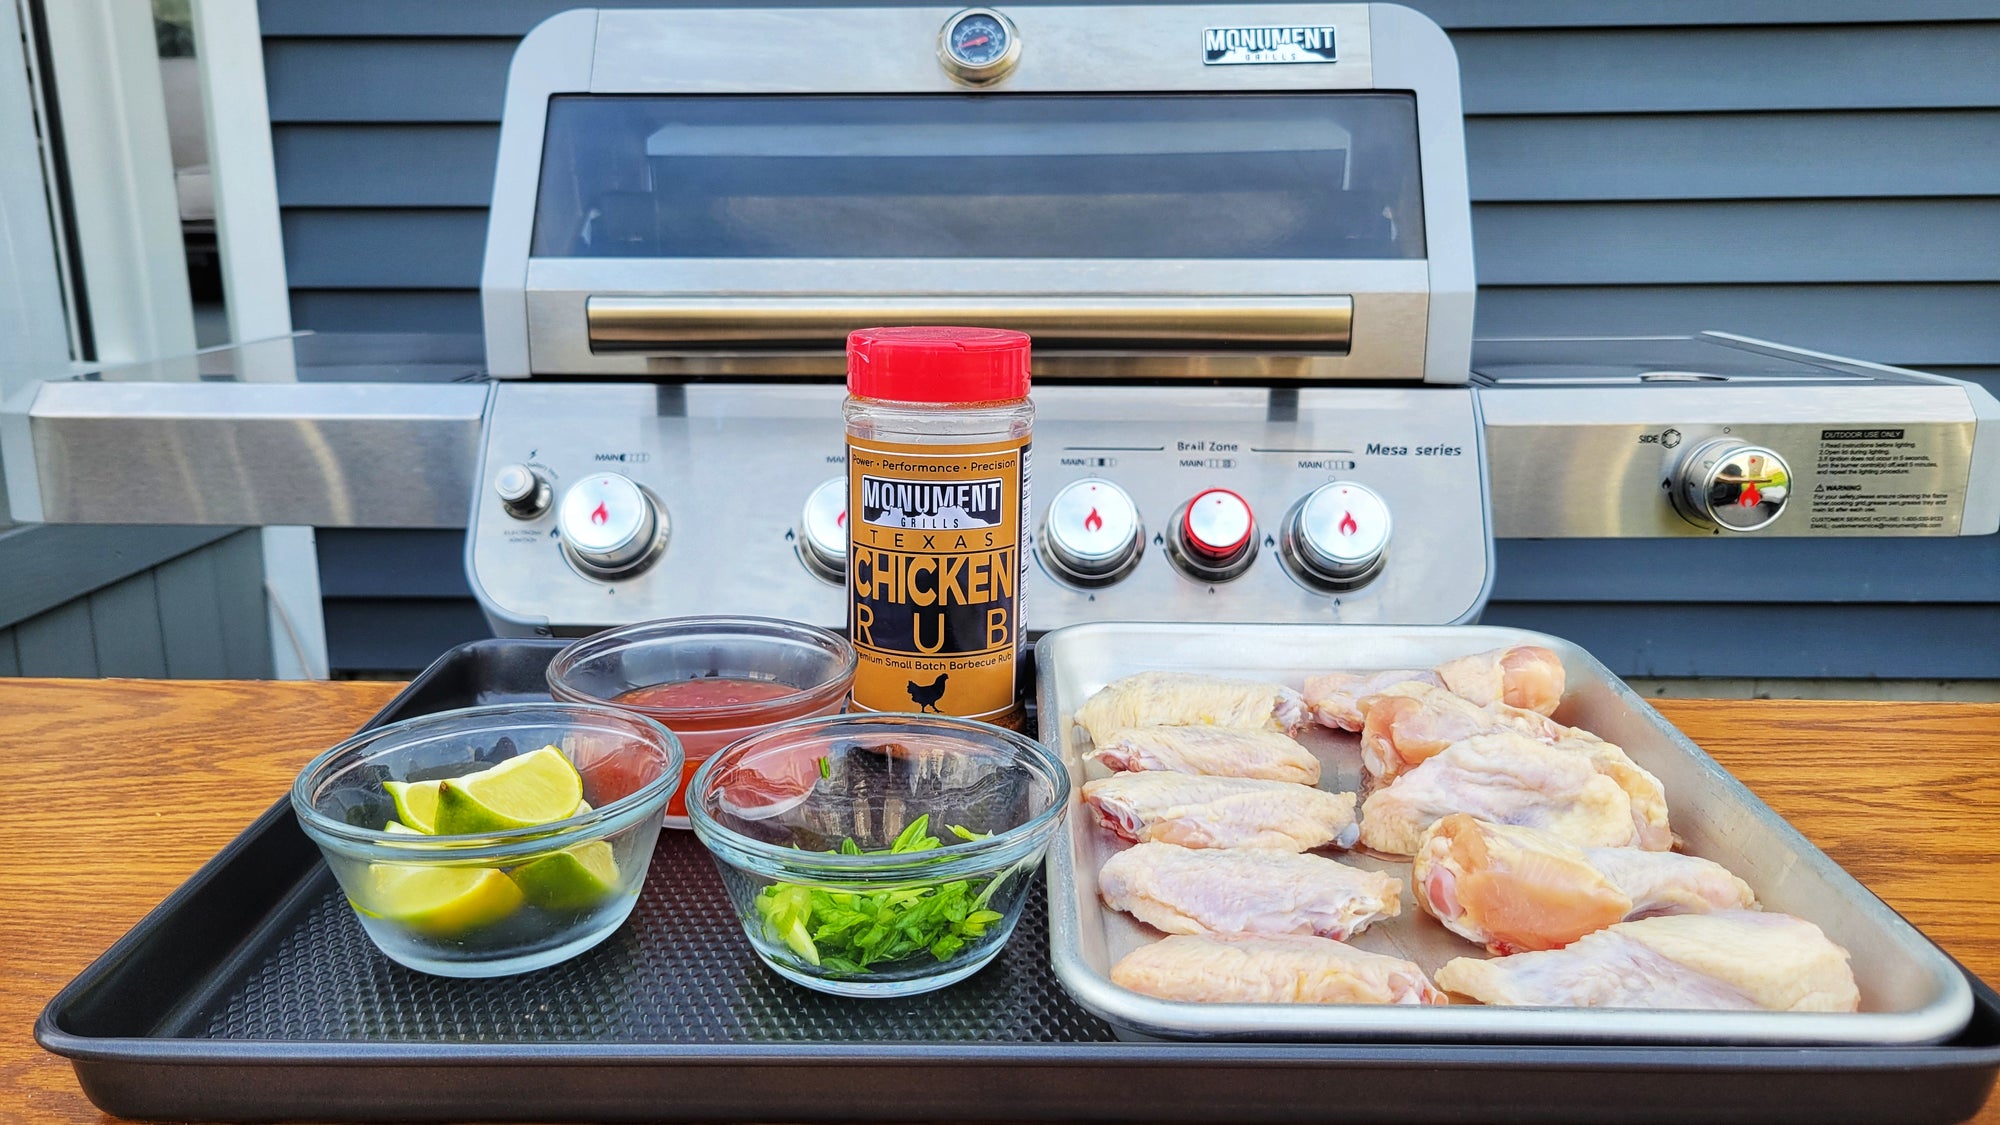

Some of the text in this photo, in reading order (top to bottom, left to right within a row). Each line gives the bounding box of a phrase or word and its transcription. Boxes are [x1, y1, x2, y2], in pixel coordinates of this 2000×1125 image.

[1205, 27, 1334, 51] MONUMENT
[1638, 434, 1659, 444] SIDE
[1823, 431, 1863, 439] OUTDOOR
[1209, 441, 1238, 451] Zone
[1365, 443, 1462, 456] Mesa series
[852, 454, 1016, 473] Power Performance Precision
[1061, 458, 1085, 466] MAIN
[864, 479, 1001, 514] MONUMENT
[901, 516, 959, 529] GRILLS
[870, 529, 993, 550] TEXAS
[854, 546, 1014, 608] CHICKEN
[857, 602, 1009, 655] RUB
[857, 650, 1012, 671] emium Small Batch Barbecue Rub
